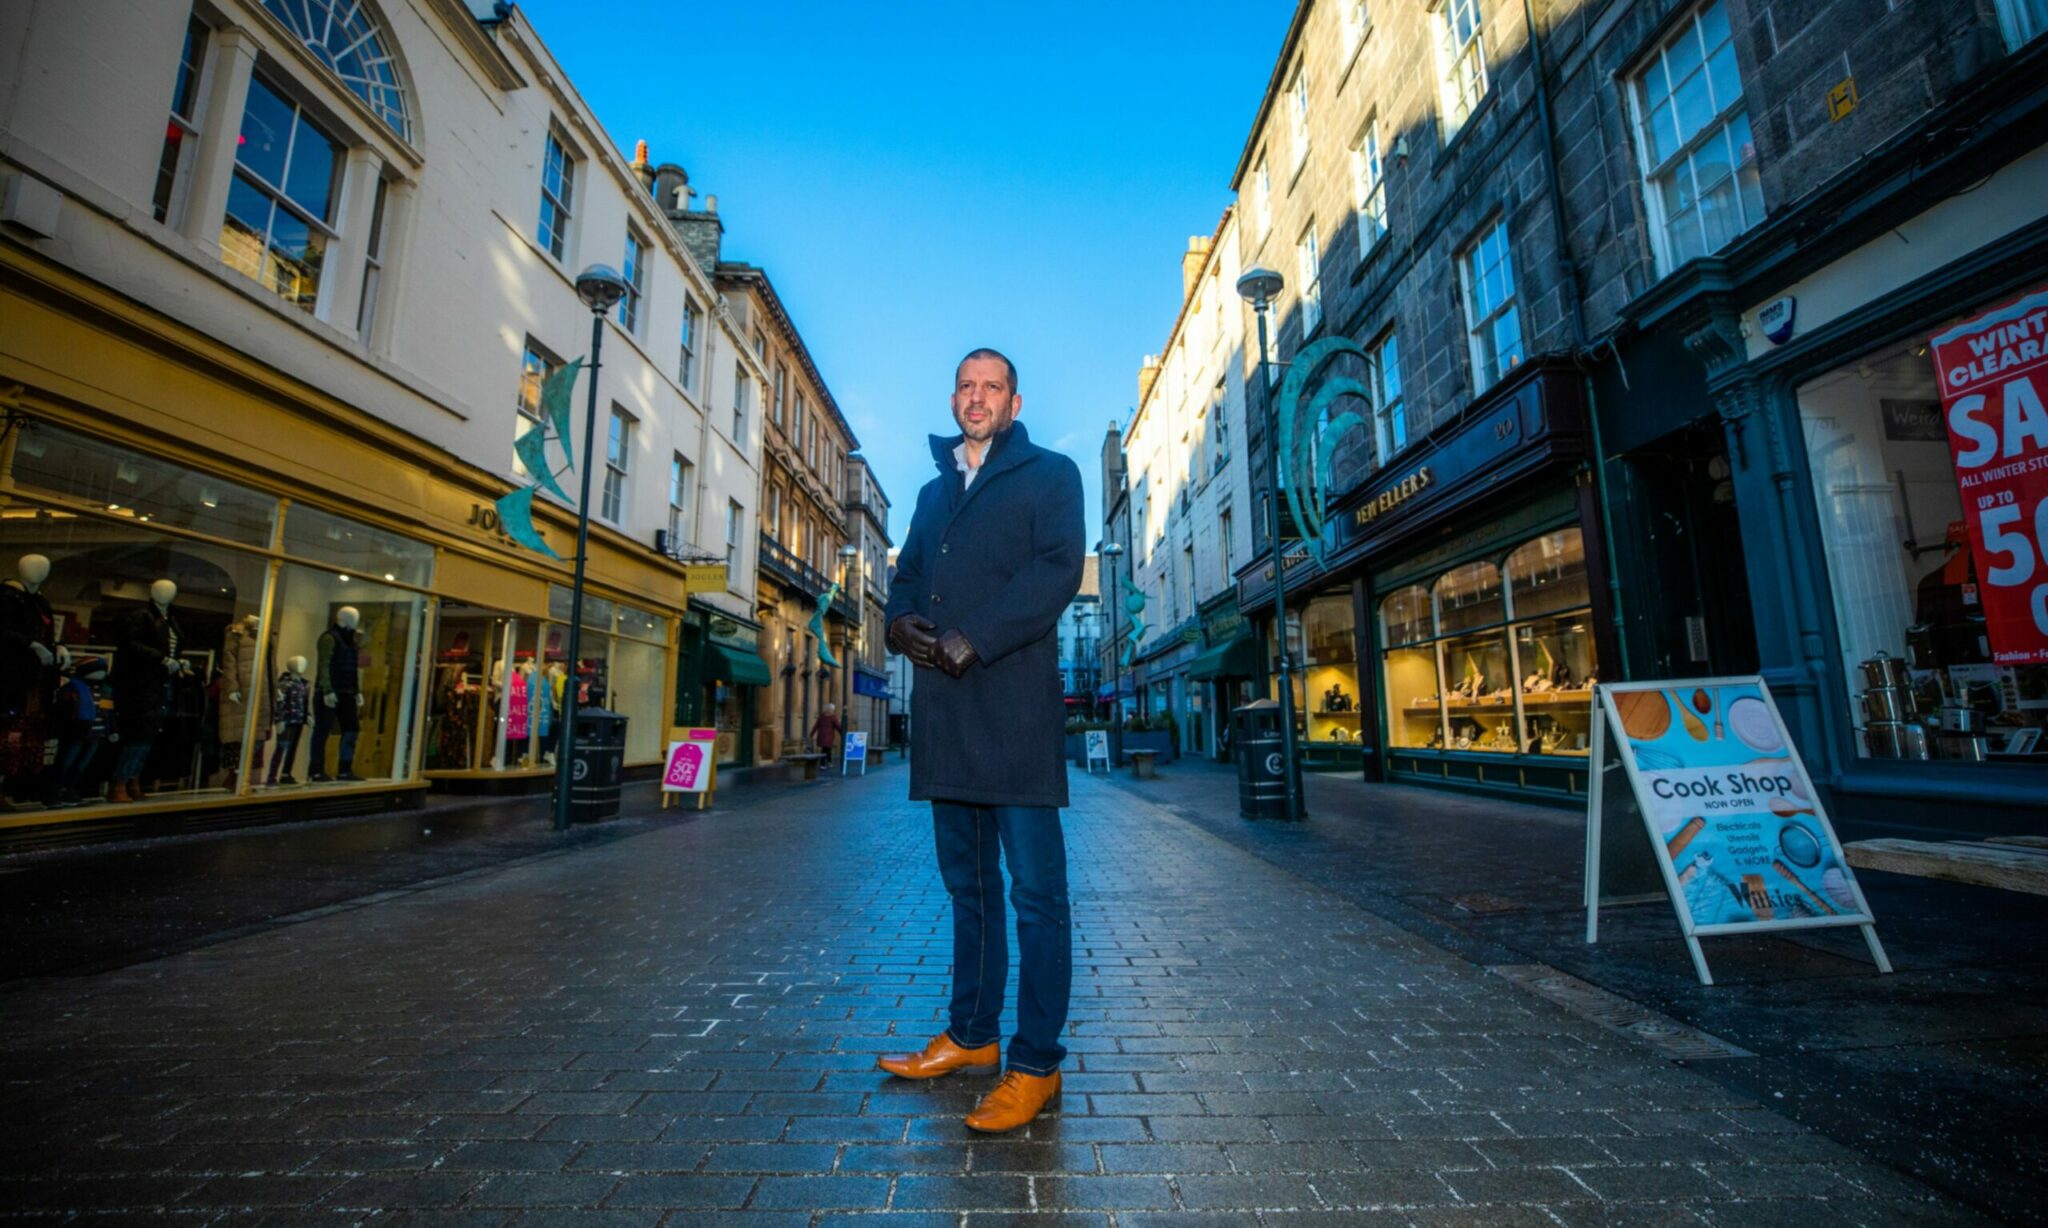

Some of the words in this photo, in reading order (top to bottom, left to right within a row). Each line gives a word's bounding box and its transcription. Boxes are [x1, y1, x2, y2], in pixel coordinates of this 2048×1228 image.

[1968, 311, 2048, 357] WINT
[1949, 333, 2048, 387] CLEAR
[1494, 417, 1515, 440] 20
[1961, 473, 1982, 488] ALL
[1982, 461, 2028, 483] WINTER
[1355, 467, 1431, 526] JEWELLERS
[1977, 494, 1995, 510] UP
[1995, 490, 2014, 505] TO
[1994, 650, 2031, 661] Fashion
[1652, 775, 1725, 799] Cook
[1726, 772, 1792, 797] Shop
[1704, 800, 1728, 809] NOW
[1730, 798, 1755, 808] OPEN
[1716, 822, 1762, 832] Electricals
[1727, 833, 1760, 842] Utensils
[1728, 844, 1768, 855] Gadgets
[1744, 855, 1771, 865] MORE
[1727, 881, 1801, 909] Wilkies
